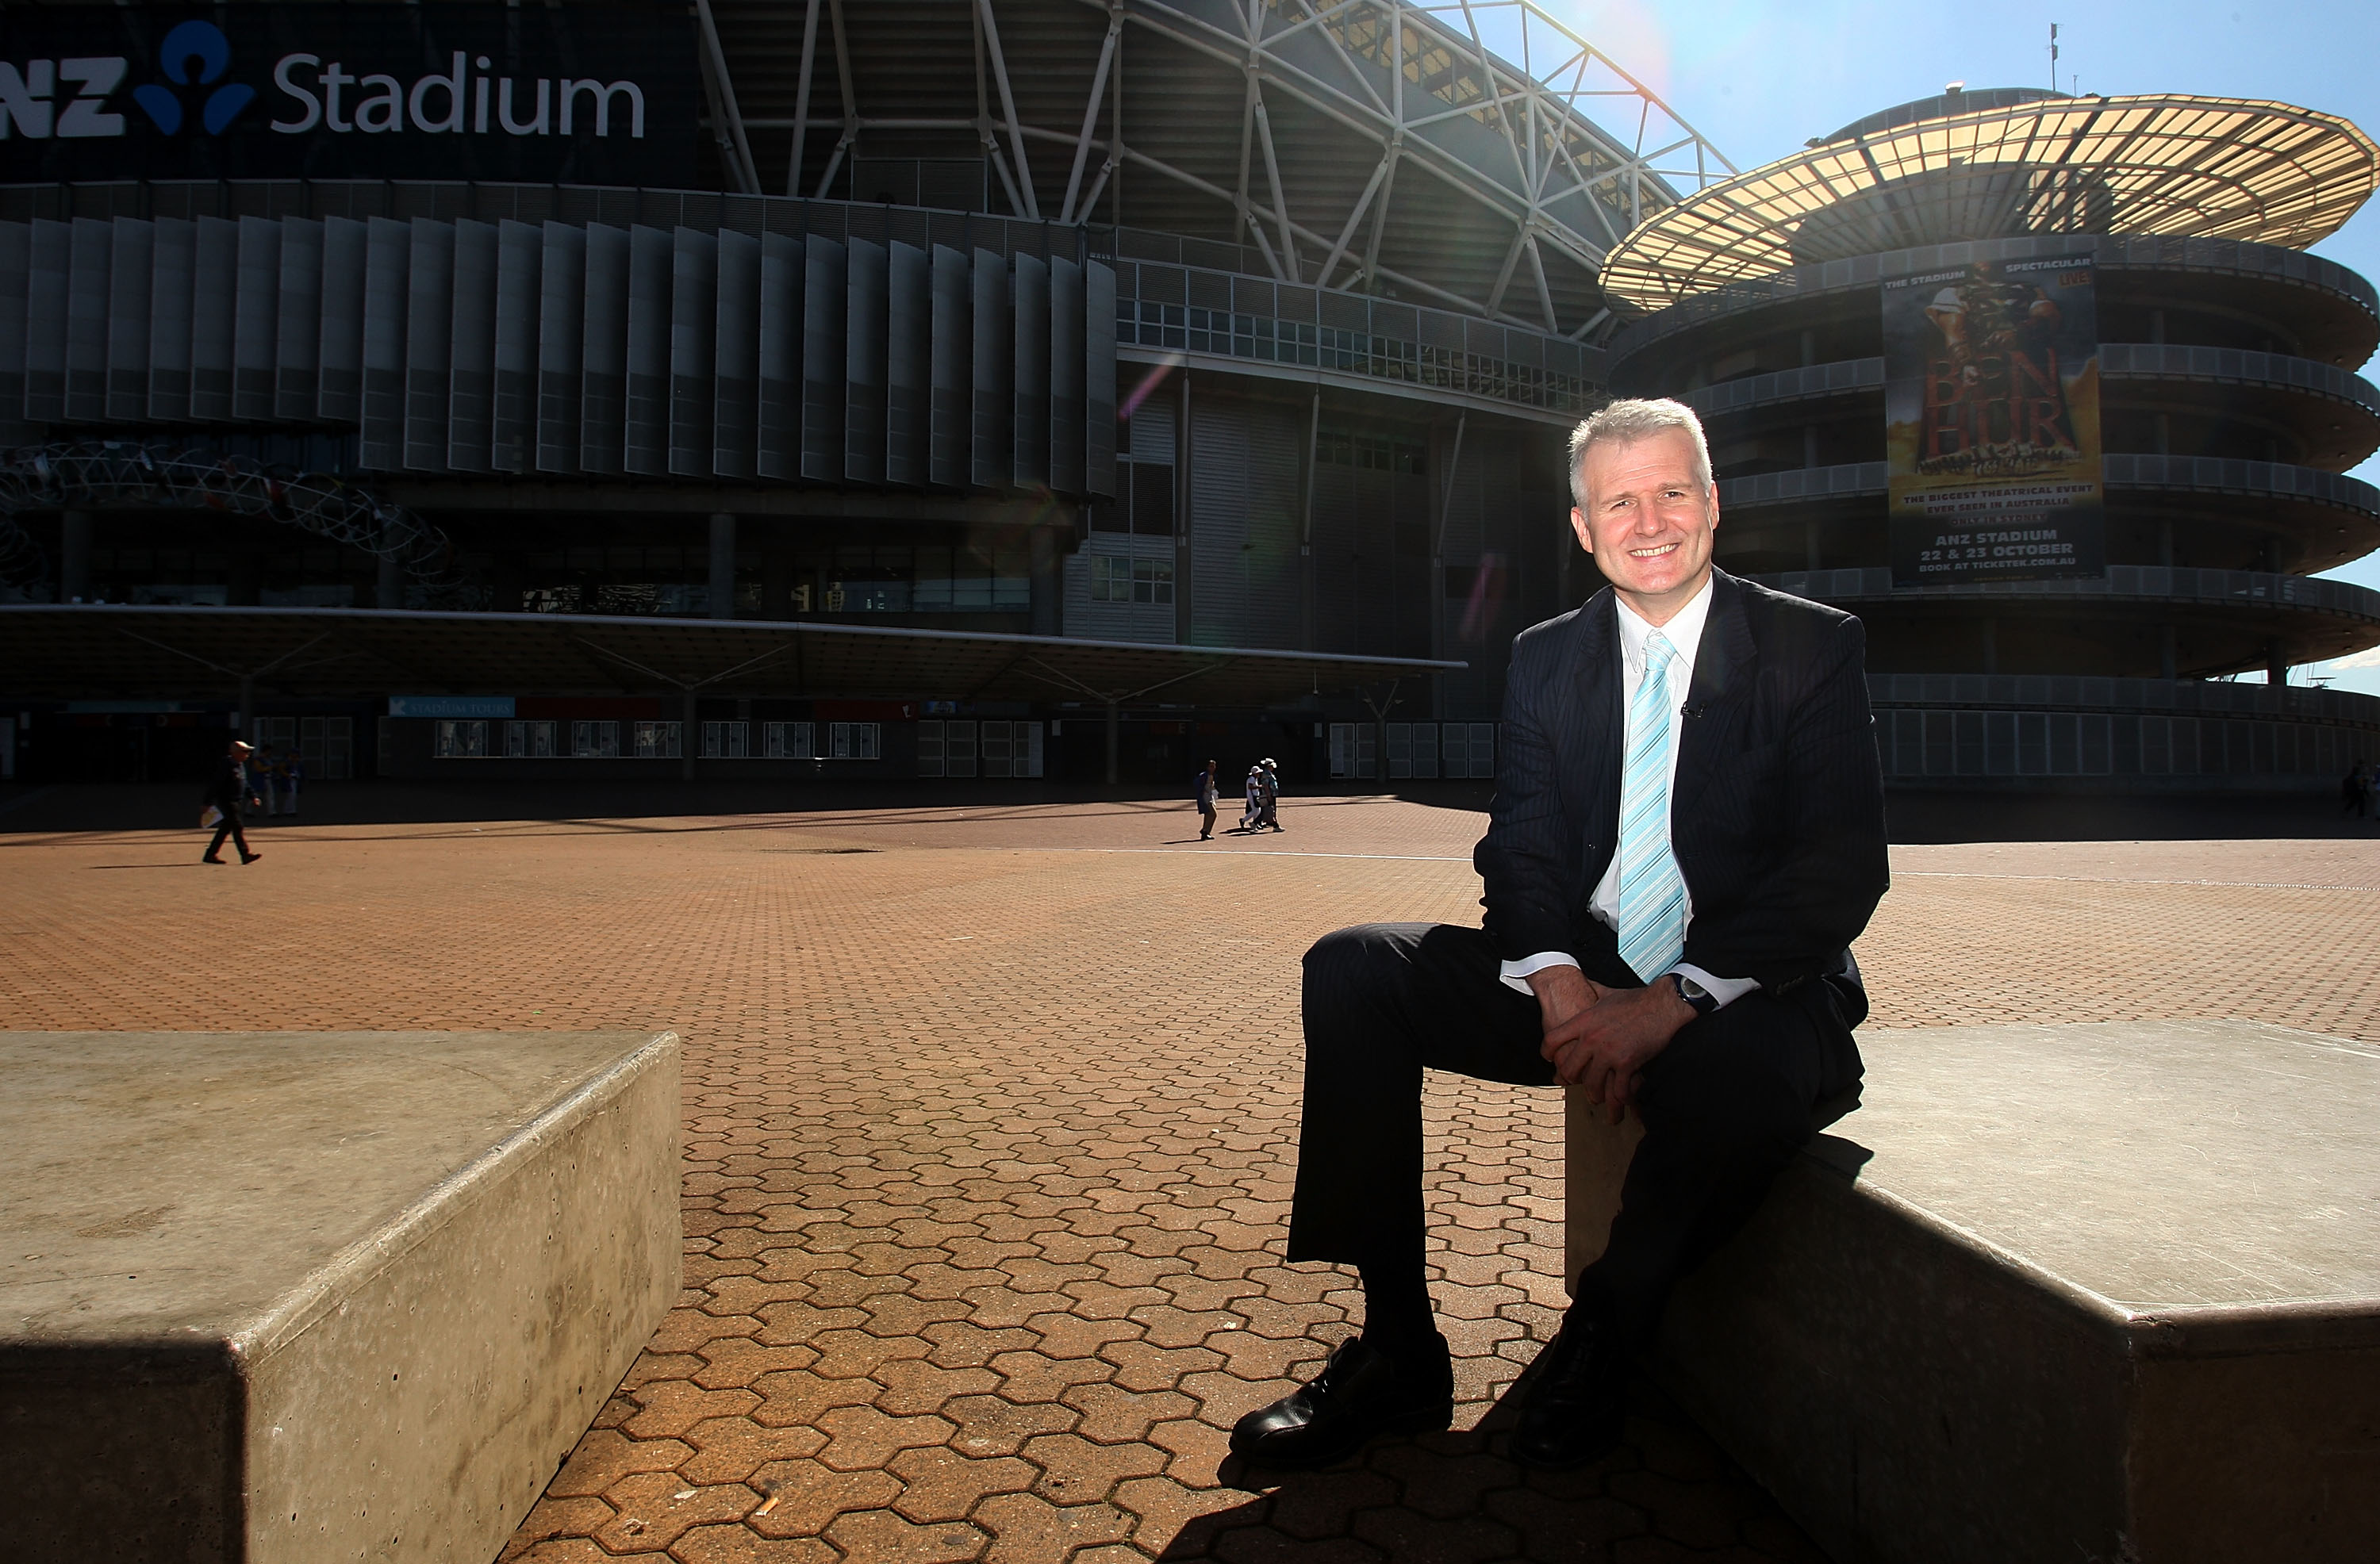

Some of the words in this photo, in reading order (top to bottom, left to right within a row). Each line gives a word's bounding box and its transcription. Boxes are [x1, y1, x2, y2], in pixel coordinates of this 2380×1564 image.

[270, 51, 645, 139] Stadium
[2006, 259, 2090, 274] SPECTACULAR
[1885, 279, 1907, 289] THE
[1910, 270, 1965, 286] STADIUM
[1927, 346, 2057, 408] BEN
[1926, 397, 2076, 460] HUR
[1929, 492, 1976, 501] BIGGEST
[1981, 486, 2052, 498] THEATRICAL
[2056, 485, 2092, 493] EVENT
[1927, 505, 1955, 514] EVER
[1959, 503, 1987, 512] SEEN
[2006, 497, 2069, 508] AUSTRALIA
[1951, 517, 1979, 526] ONLY
[1999, 513, 2044, 522] SYDNEY
[1936, 534, 1971, 546] ANZ
[1976, 529, 2057, 544] STADIUM
[1920, 550, 1941, 561] 22
[1948, 549, 1960, 559] &
[1966, 547, 1987, 558] 23
[1993, 542, 2074, 557] OCTOBER
[1954, 562, 1968, 570] AT
[1972, 558, 2075, 569] TICKETEK.COM.AU
[409, 700, 466, 714] STADIUM
[469, 703, 510, 715] TOURS
